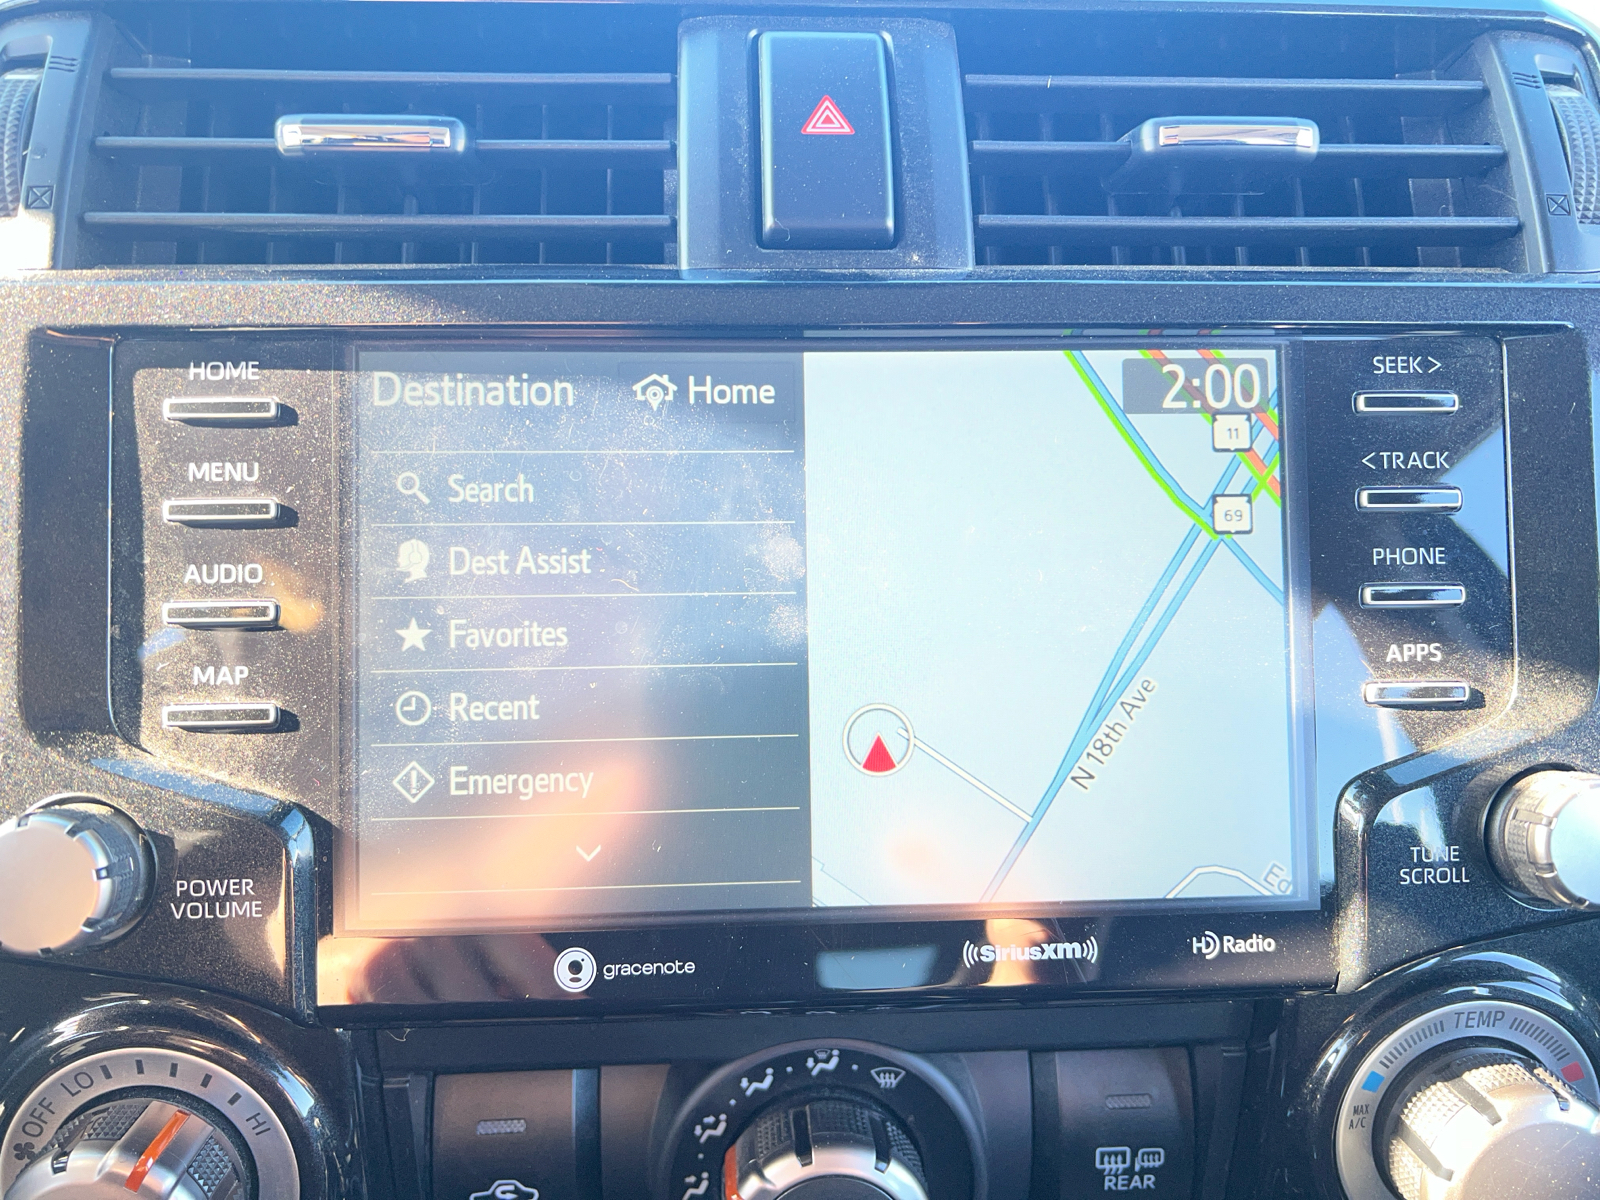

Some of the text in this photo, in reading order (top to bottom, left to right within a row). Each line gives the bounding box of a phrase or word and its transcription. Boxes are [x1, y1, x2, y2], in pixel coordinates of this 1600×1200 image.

[189, 361, 259, 381] HOME
[372, 371, 574, 407] Destination
[688, 375, 776, 405] Home
[1161, 363, 1261, 410] 2:00
[1226, 427, 1240, 440] 11
[188, 462, 259, 482] MENU
[448, 474, 534, 503] Search
[1223, 509, 1243, 523] 69
[449, 545, 592, 576] Dest Assist
[1372, 547, 1446, 566] PHONE
[183, 563, 263, 584] AUDIO
[448, 619, 569, 648] Favorites
[1385, 642, 1442, 663] APPS
[193, 665, 249, 686] MAP
[449, 692, 540, 722] Recent
[1070, 678, 1156, 791] N 18th Ave
[449, 765, 594, 799] Emergency
[1410, 846, 1460, 863] TUNE
[1399, 867, 1470, 885] SCROLL
[176, 879, 255, 897] POWER
[170, 901, 263, 920] VOLUME
[1222, 934, 1276, 953] Radio
[602, 959, 696, 980] gracenote
[1454, 1010, 1506, 1029] TEMP
[22, 1071, 95, 1139] OFF LO
[1353, 1103, 1370, 1116] MAX
[245, 1112, 271, 1137] HI
[1348, 1117, 1367, 1130] A/C
[1104, 1175, 1156, 1191] REAR
